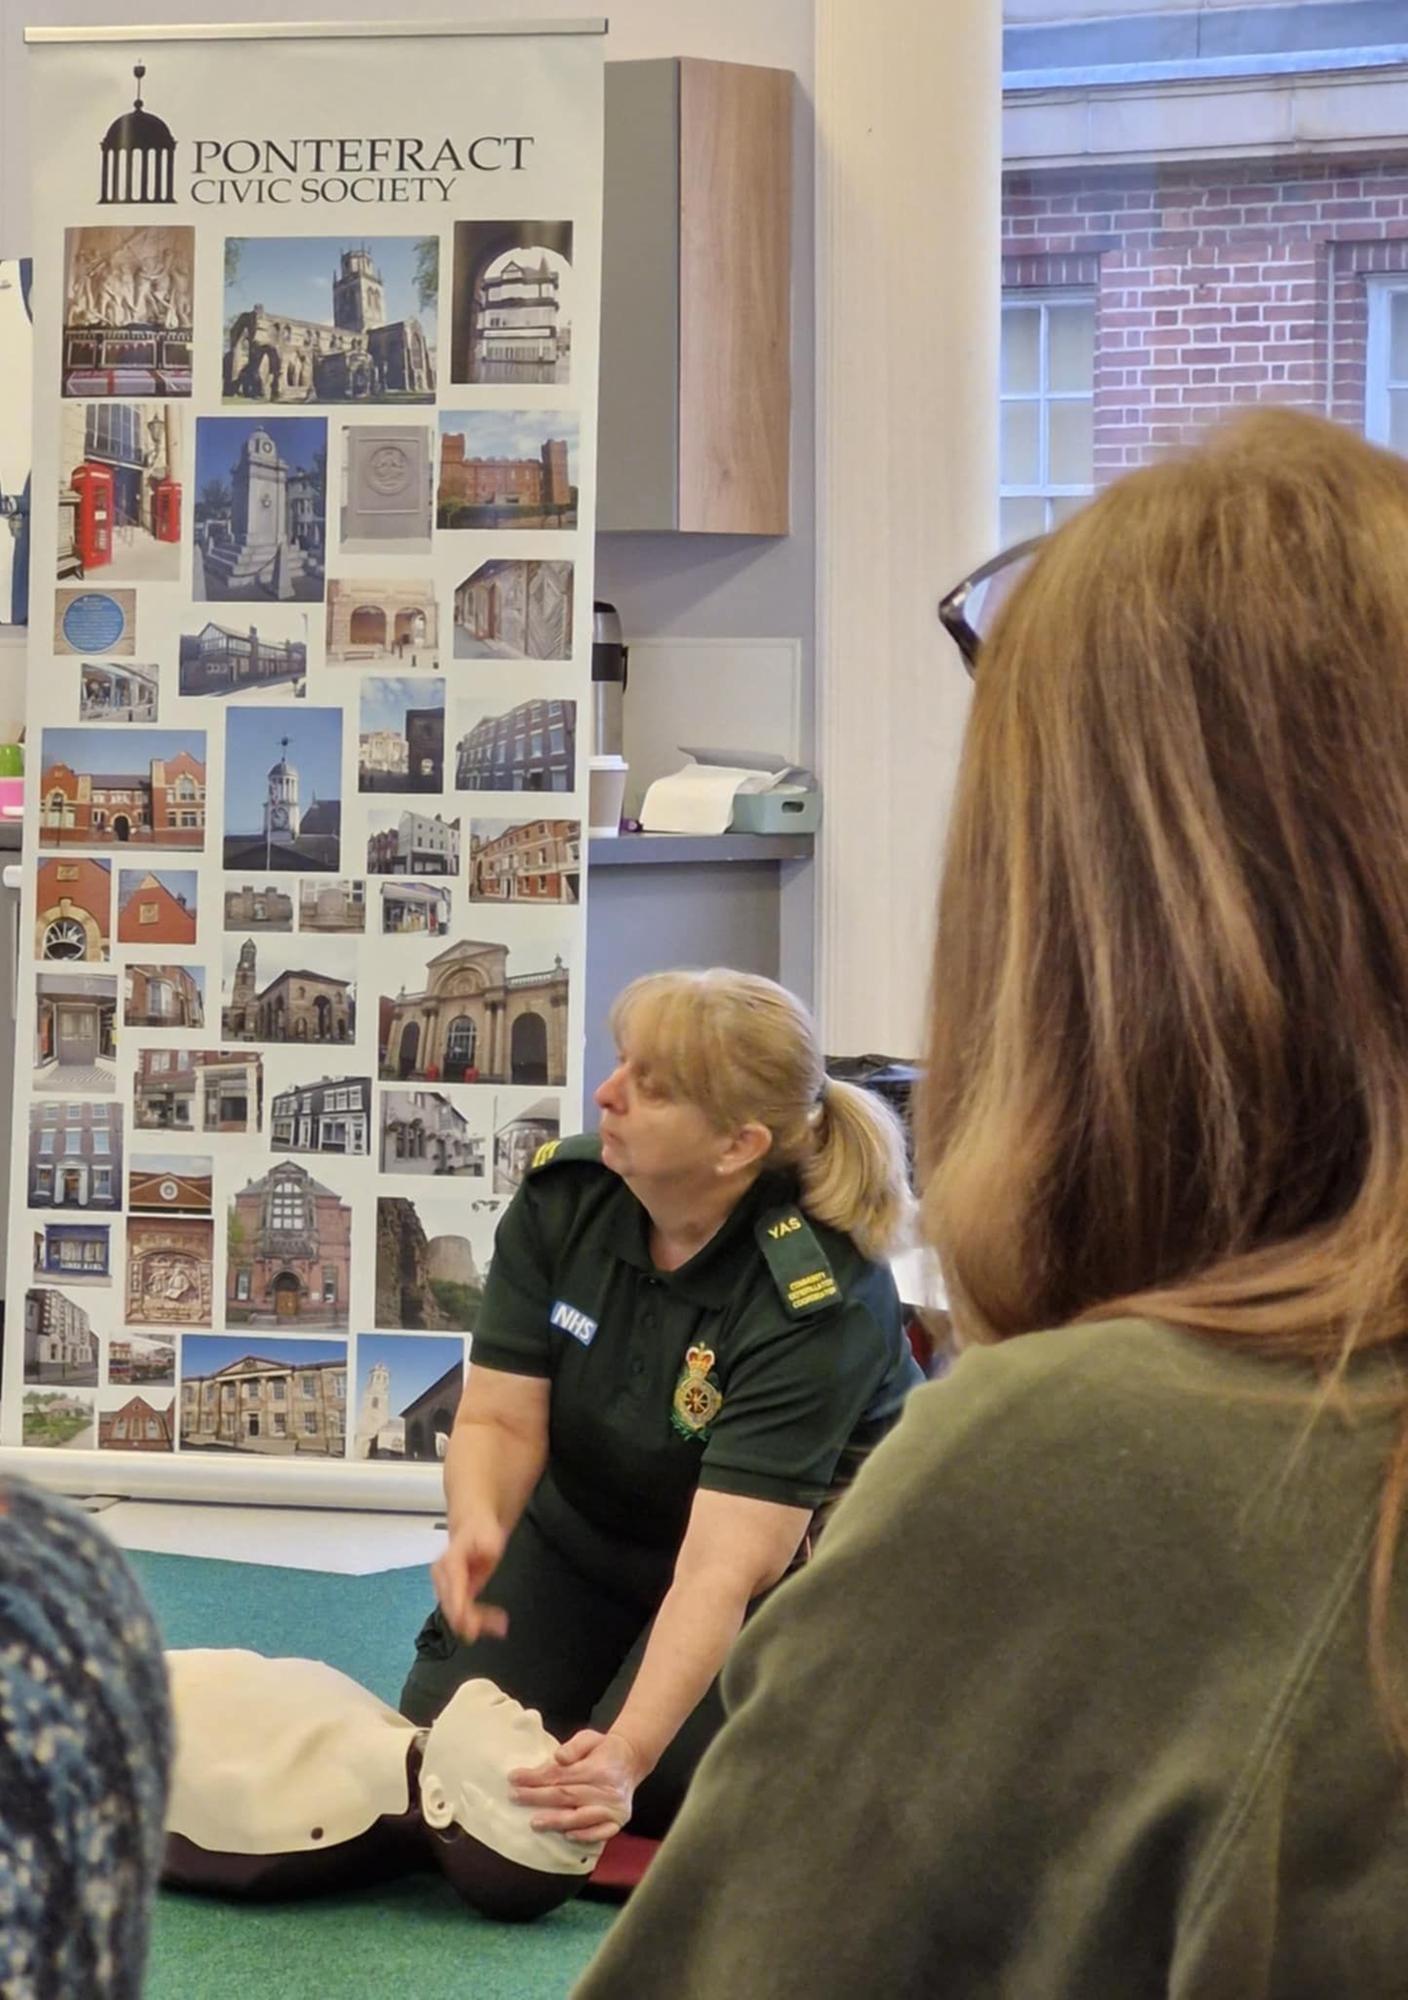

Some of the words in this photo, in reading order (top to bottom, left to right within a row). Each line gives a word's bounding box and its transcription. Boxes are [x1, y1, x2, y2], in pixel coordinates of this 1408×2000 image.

[191, 136, 534, 174] PONTEFRACT
[191, 178, 292, 205] CIVIC
[301, 177, 456, 203] SOCIETY
[767, 1216, 802, 1239] YAS
[551, 1304, 595, 1340] NHS
